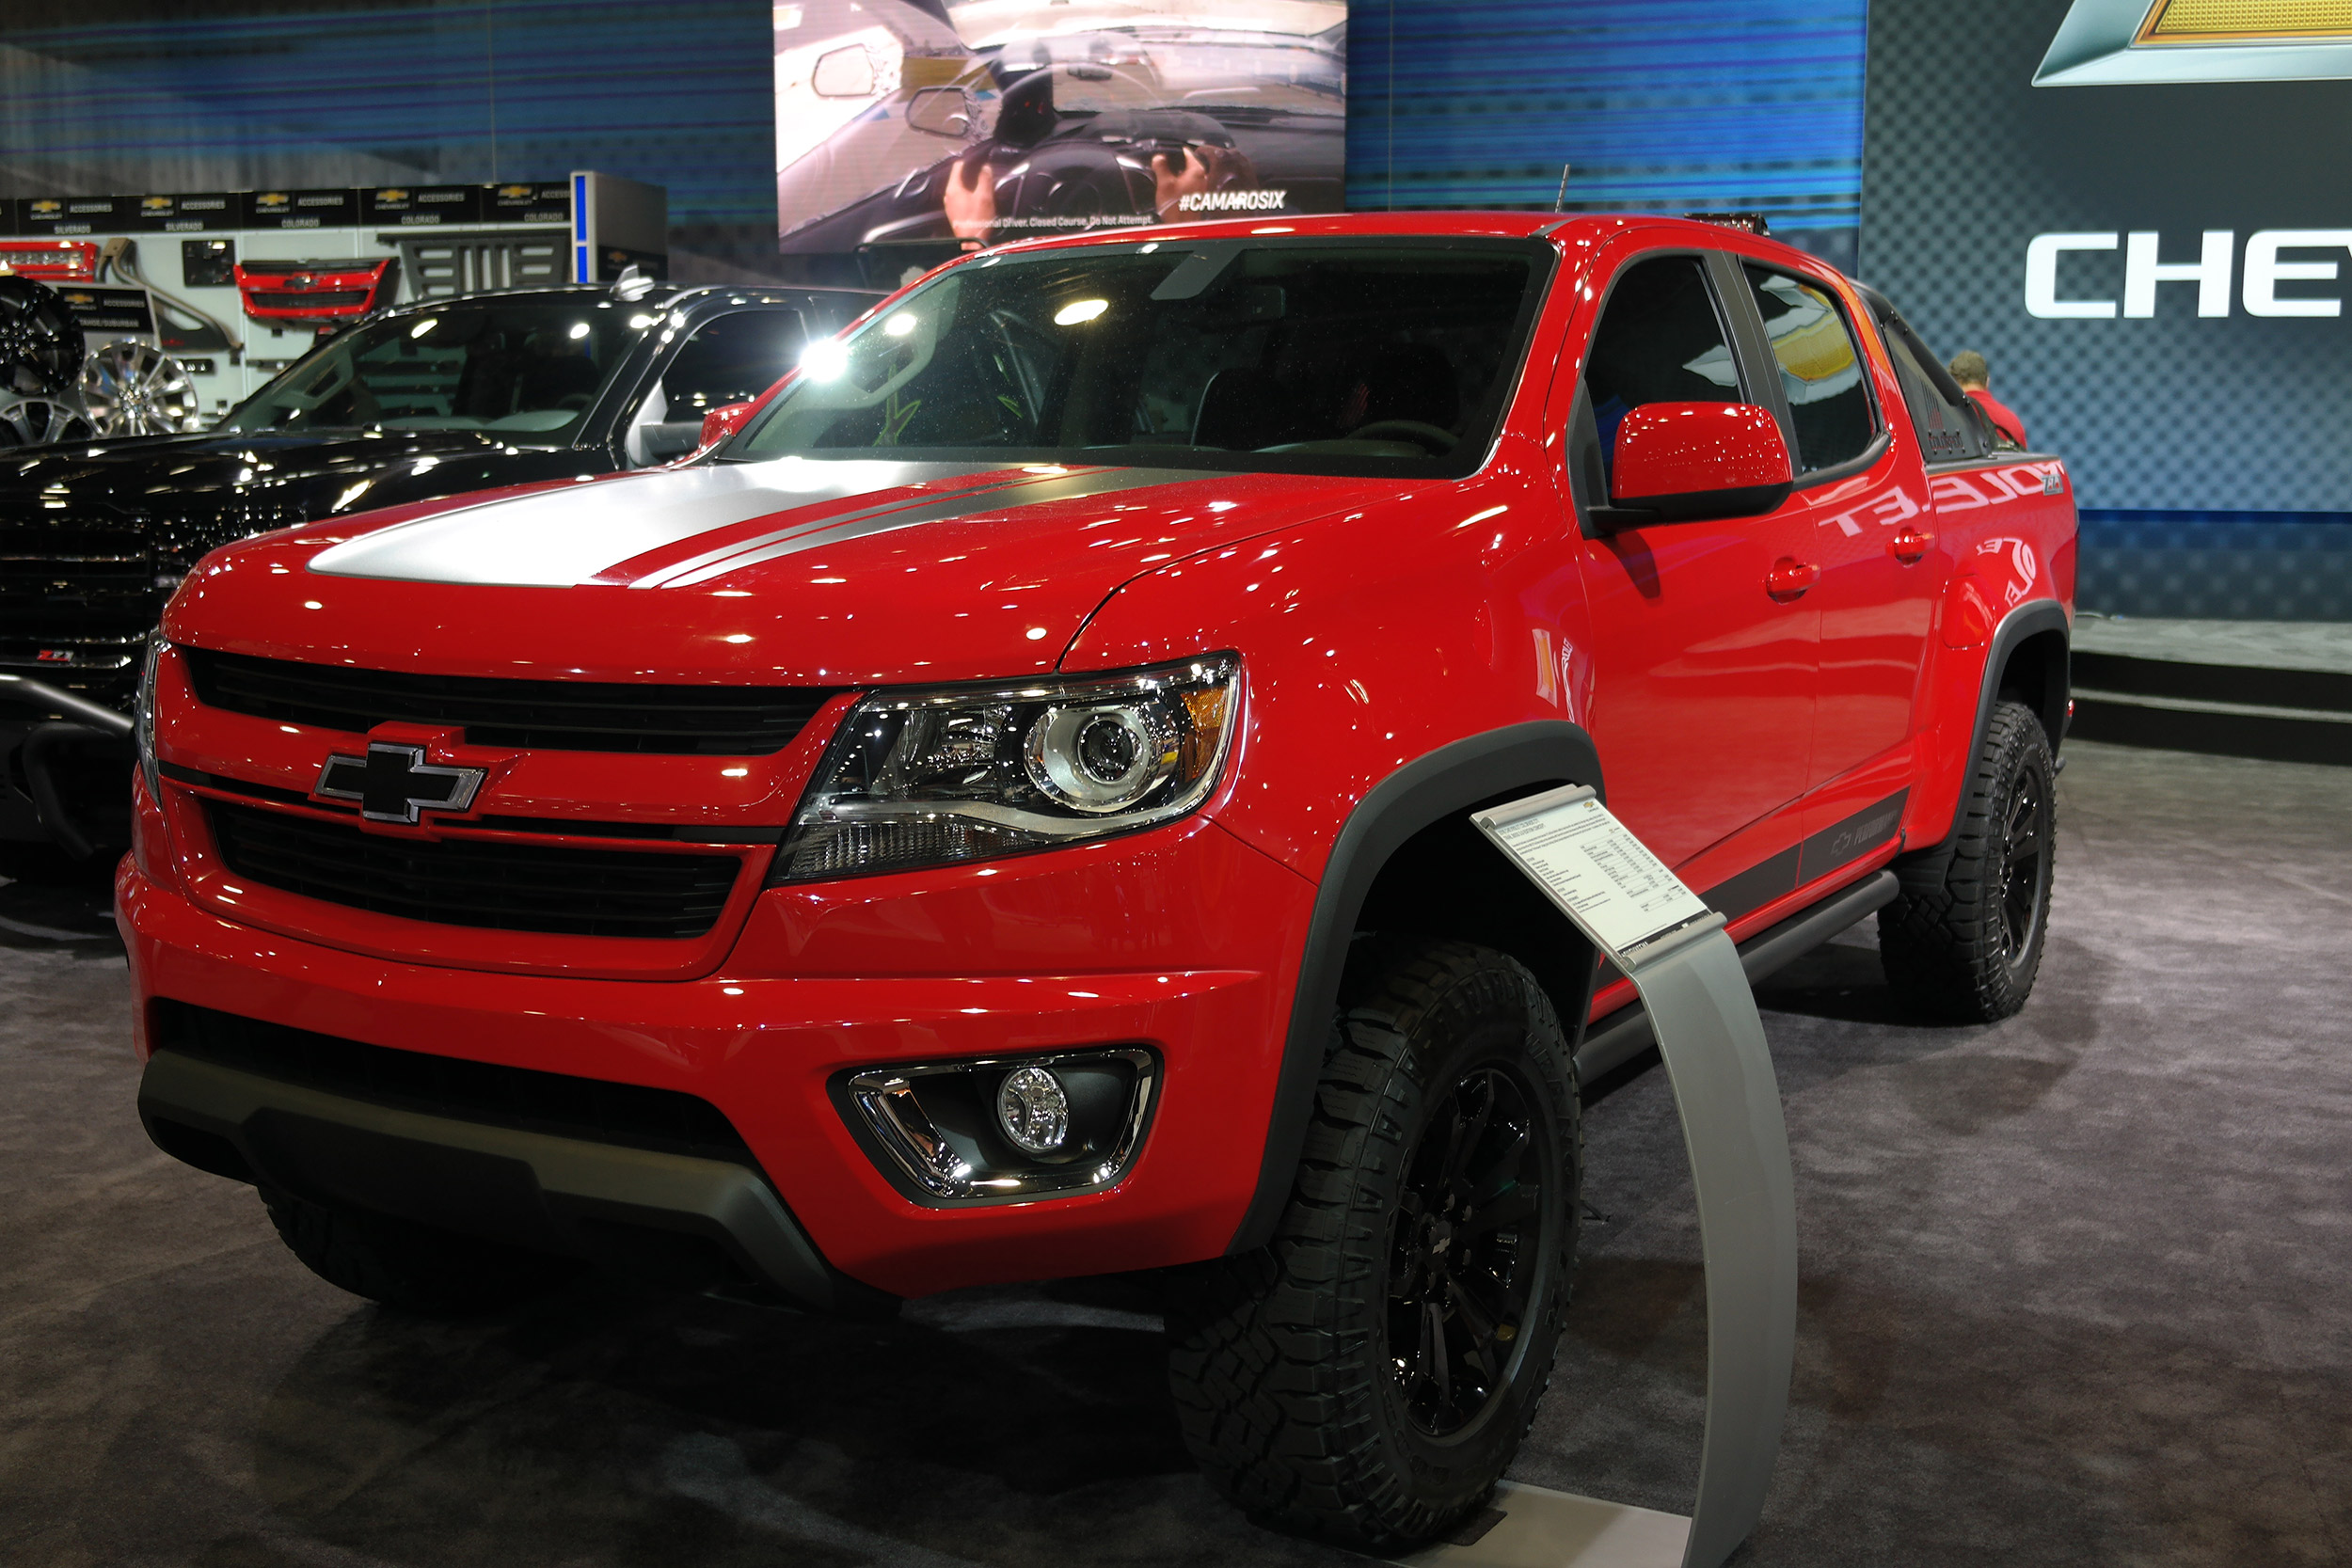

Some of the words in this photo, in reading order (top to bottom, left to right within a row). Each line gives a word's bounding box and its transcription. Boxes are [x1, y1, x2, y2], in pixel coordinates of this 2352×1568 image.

[418, 192, 464, 203] ACCESSORIES
[540, 188, 572, 198] ACCESSO
[181, 199, 225, 211] ACCESSORIES
[297, 197, 344, 208] ACCESSORIES
[1178, 189, 1287, 212] #CAMAROSIX
[69, 203, 112, 214] ACCESSORIES
[401, 214, 439, 225] COLORADO
[524, 213, 564, 222] COLORADO
[1003, 216, 1029, 230] Driver.
[1029, 216, 1057, 229] Closed
[1103, 215, 1117, 227] Not
[1118, 214, 1154, 228] Attempt.
[165, 221, 204, 232] SILVERADO
[281, 218, 319, 229] COLORADO
[54, 224, 91, 235] SILVERADO
[2024, 229, 2352, 319] CHE
[37, 649, 74, 662] Z71
